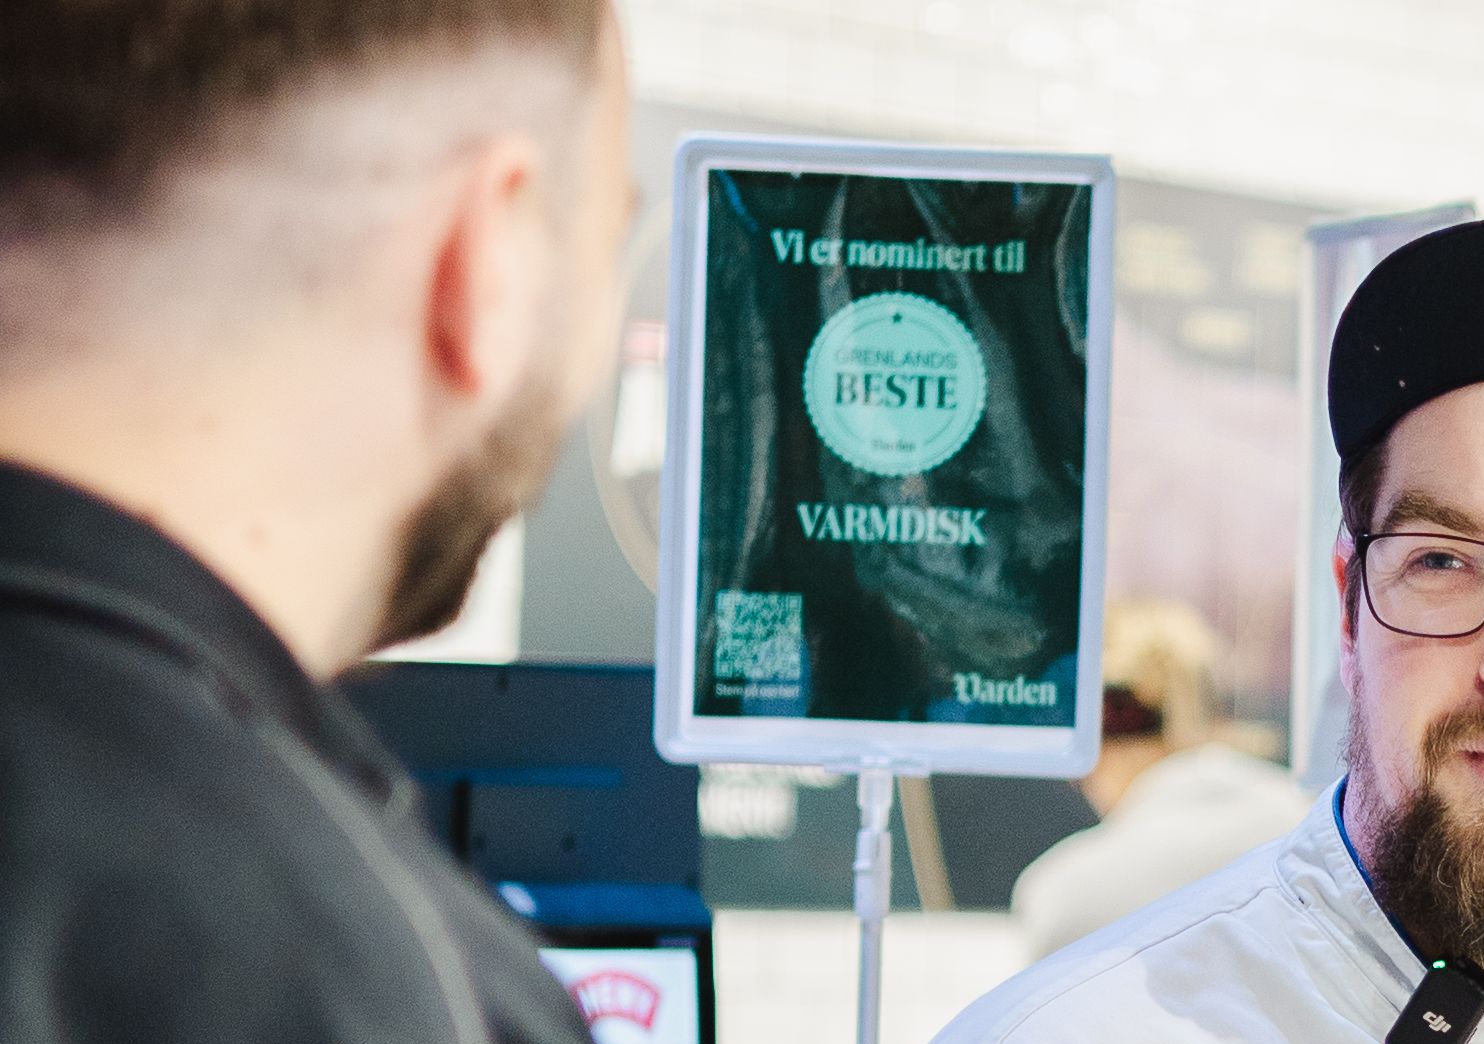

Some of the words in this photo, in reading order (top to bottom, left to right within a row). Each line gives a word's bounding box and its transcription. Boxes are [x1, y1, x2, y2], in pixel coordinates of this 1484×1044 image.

[770, 229, 804, 264] Vi
[810, 237, 843, 266] er
[847, 236, 986, 272] nominert
[993, 240, 1025, 273] til
[834, 348, 957, 369] GRENLANDS
[836, 371, 957, 409] BESTE
[797, 502, 987, 546] VARMDISK
[953, 672, 1056, 706] Varden
[1422, 1011, 1452, 1033] dji
